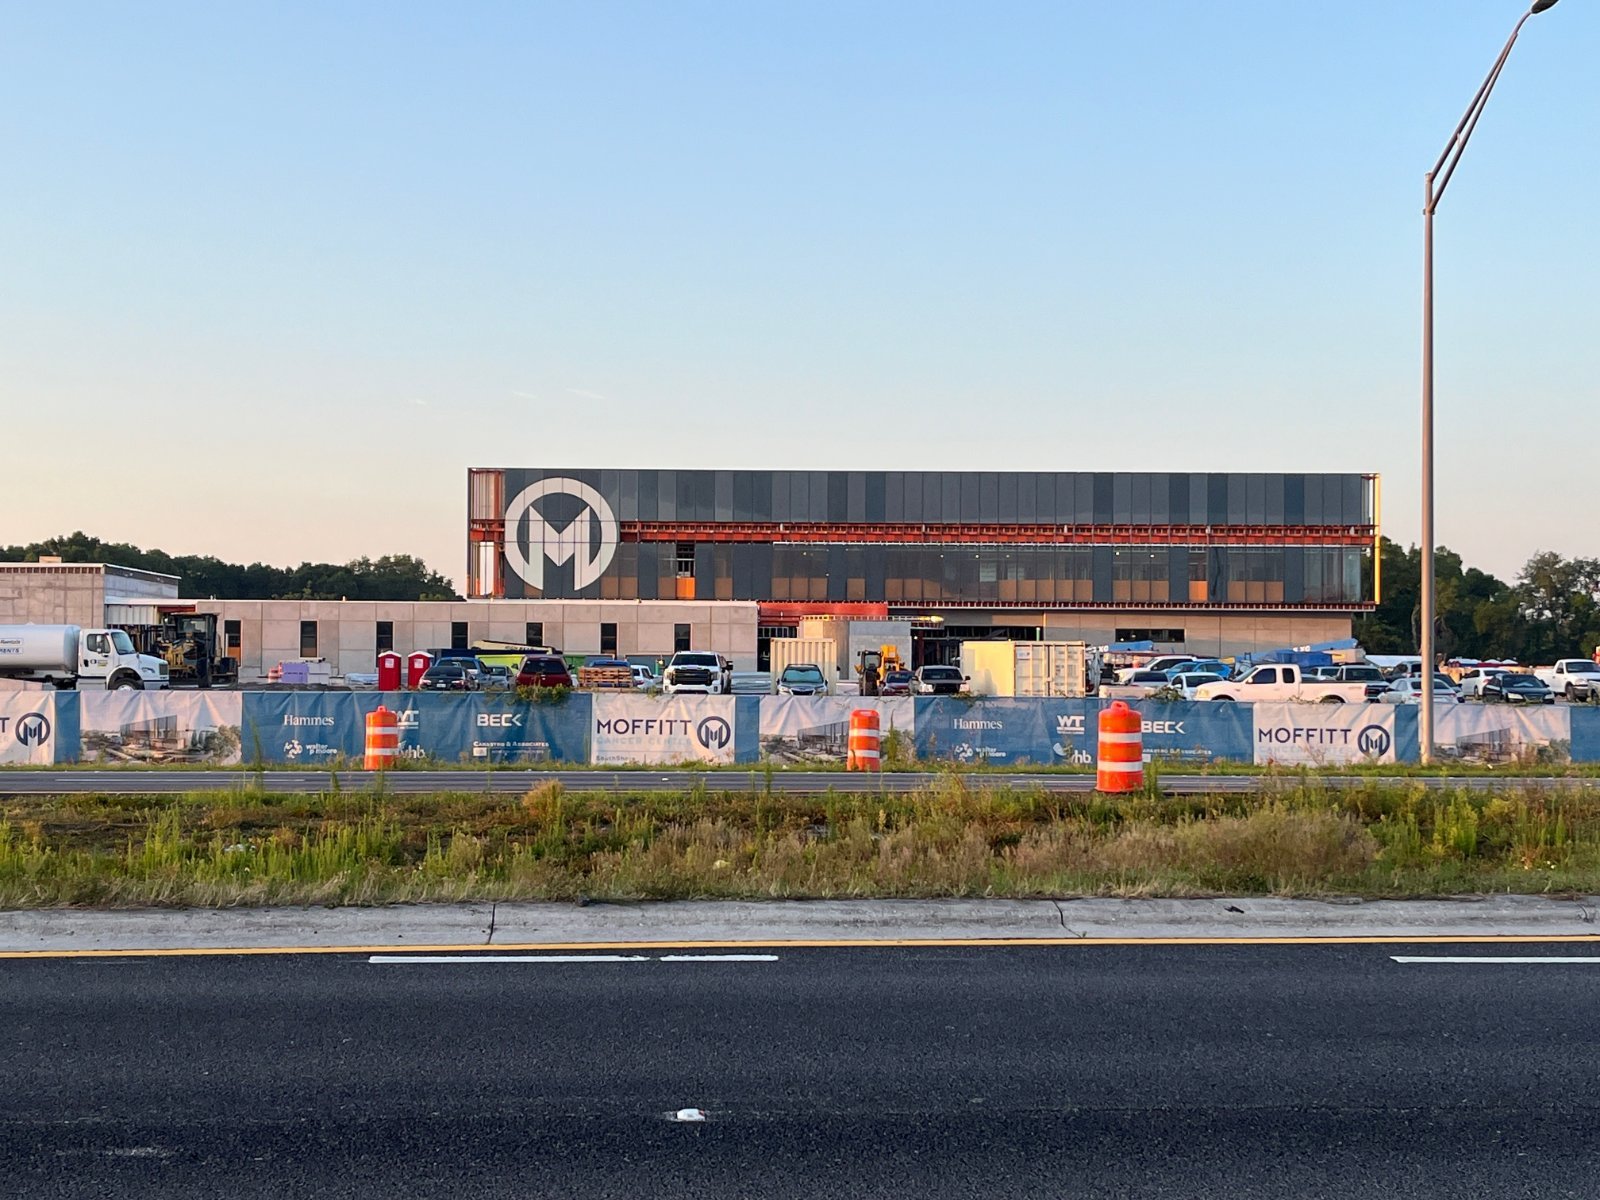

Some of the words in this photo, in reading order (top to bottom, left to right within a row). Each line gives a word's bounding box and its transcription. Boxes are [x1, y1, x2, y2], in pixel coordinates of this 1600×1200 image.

[283, 714, 335, 726] Hammes
[477, 713, 522, 727] BECK
[596, 718, 692, 736] MOFFITT
[953, 718, 1003, 730] Hammes
[1056, 715, 1085, 727] WT
[1141, 721, 1186, 735] BECK
[1258, 727, 1352, 745] MOFFITT
